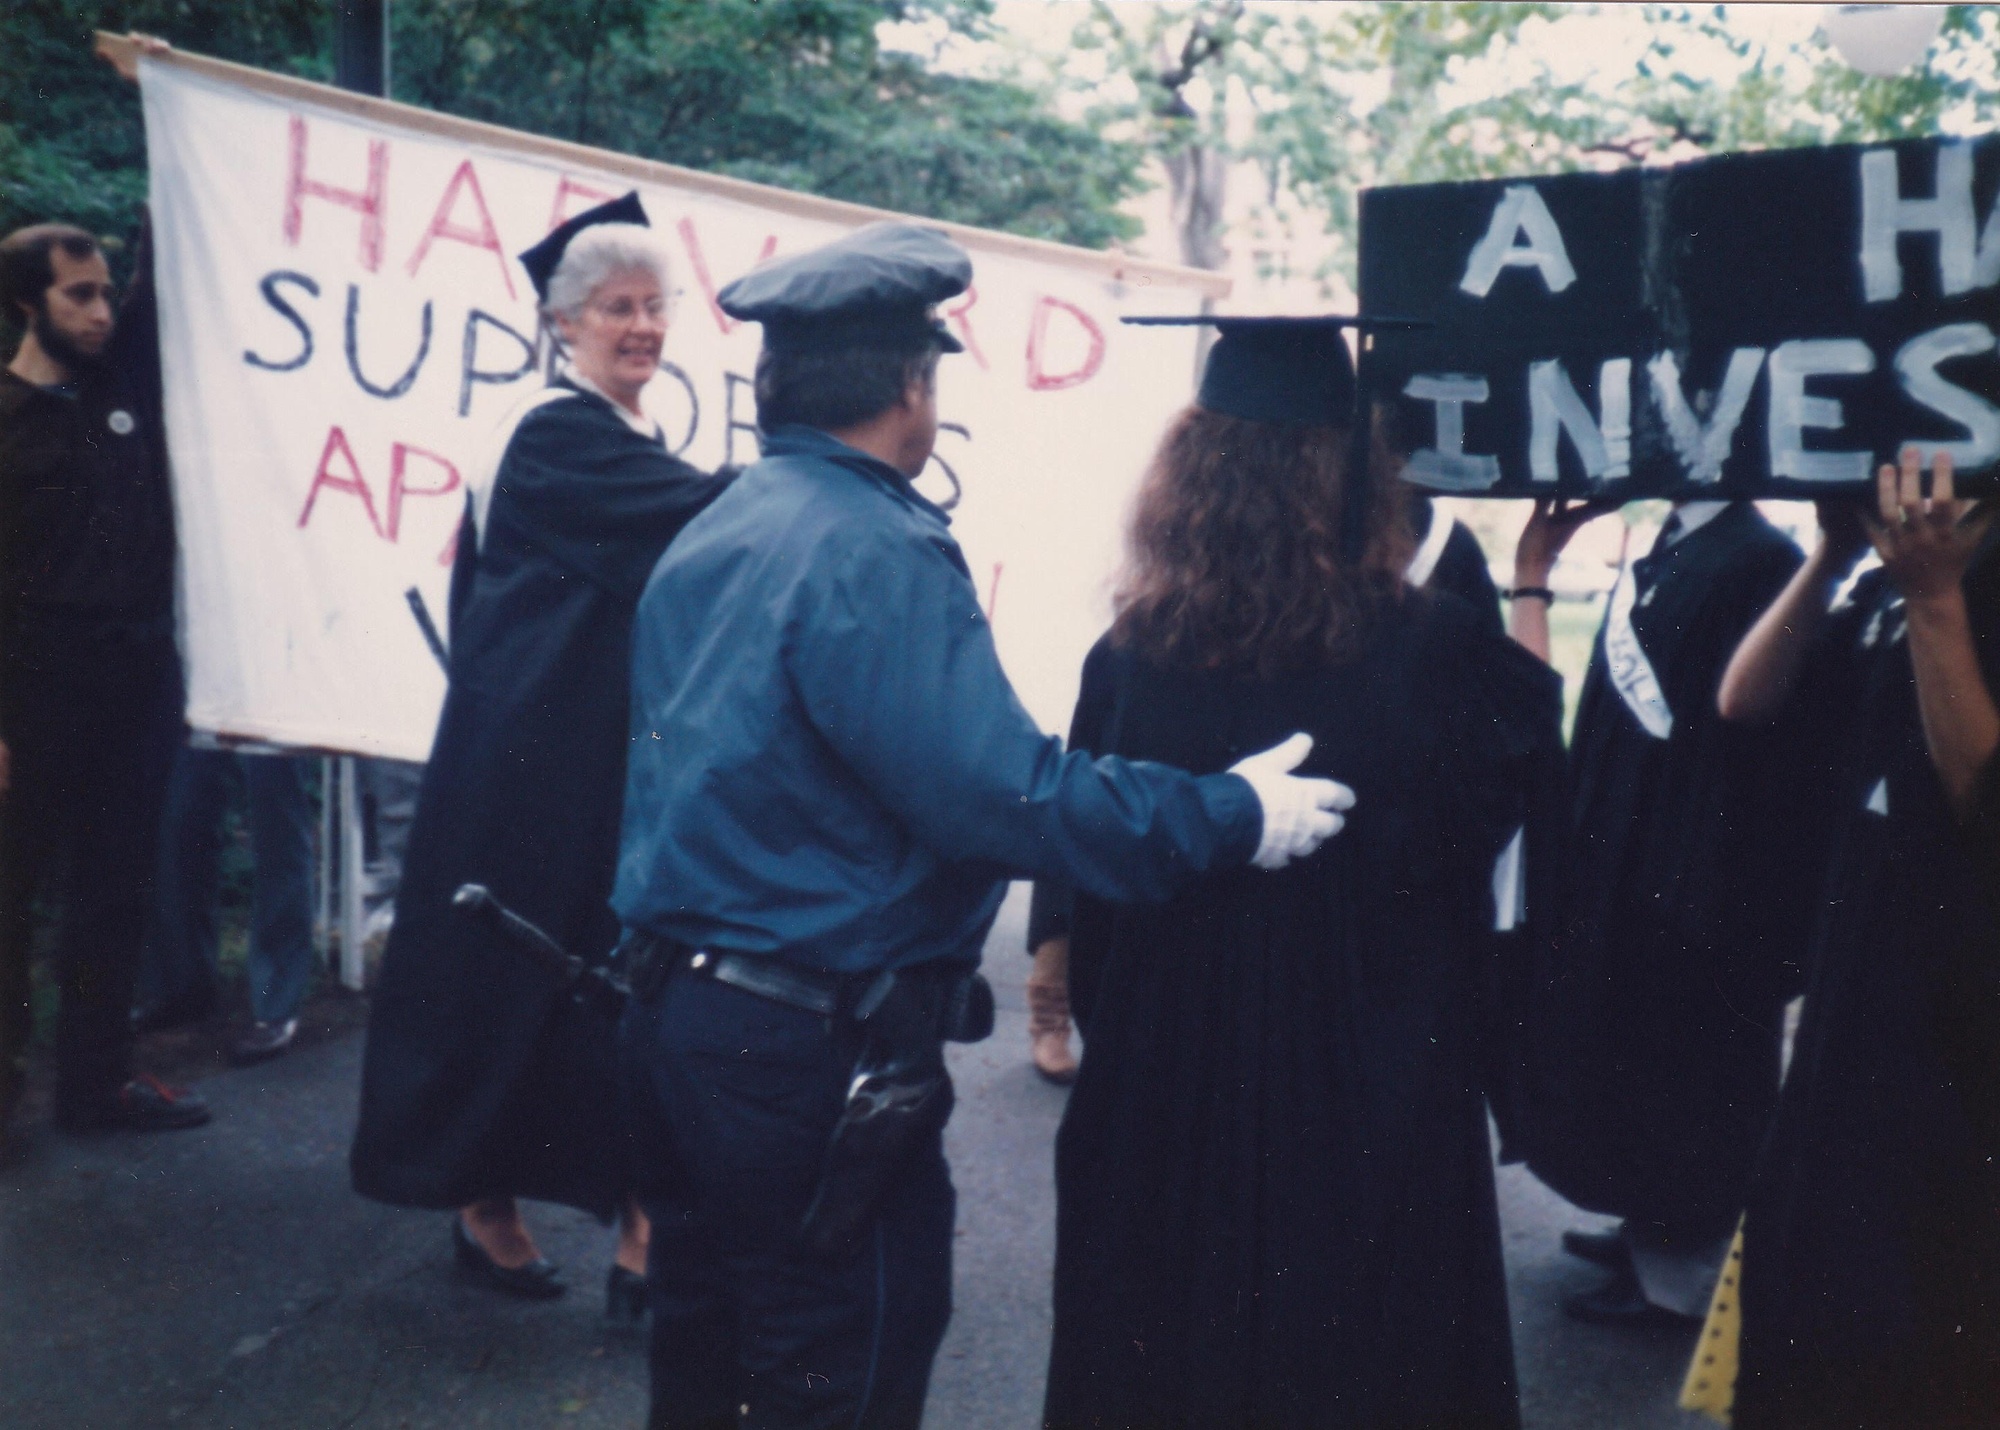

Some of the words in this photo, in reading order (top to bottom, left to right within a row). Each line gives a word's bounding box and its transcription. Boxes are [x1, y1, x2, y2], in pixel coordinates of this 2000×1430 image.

[280, 113, 1107, 392] HAVD
[1459, 184, 1578, 299] A
[243, 269, 973, 511] SUPORS
[1400, 322, 2000, 492] INVES
